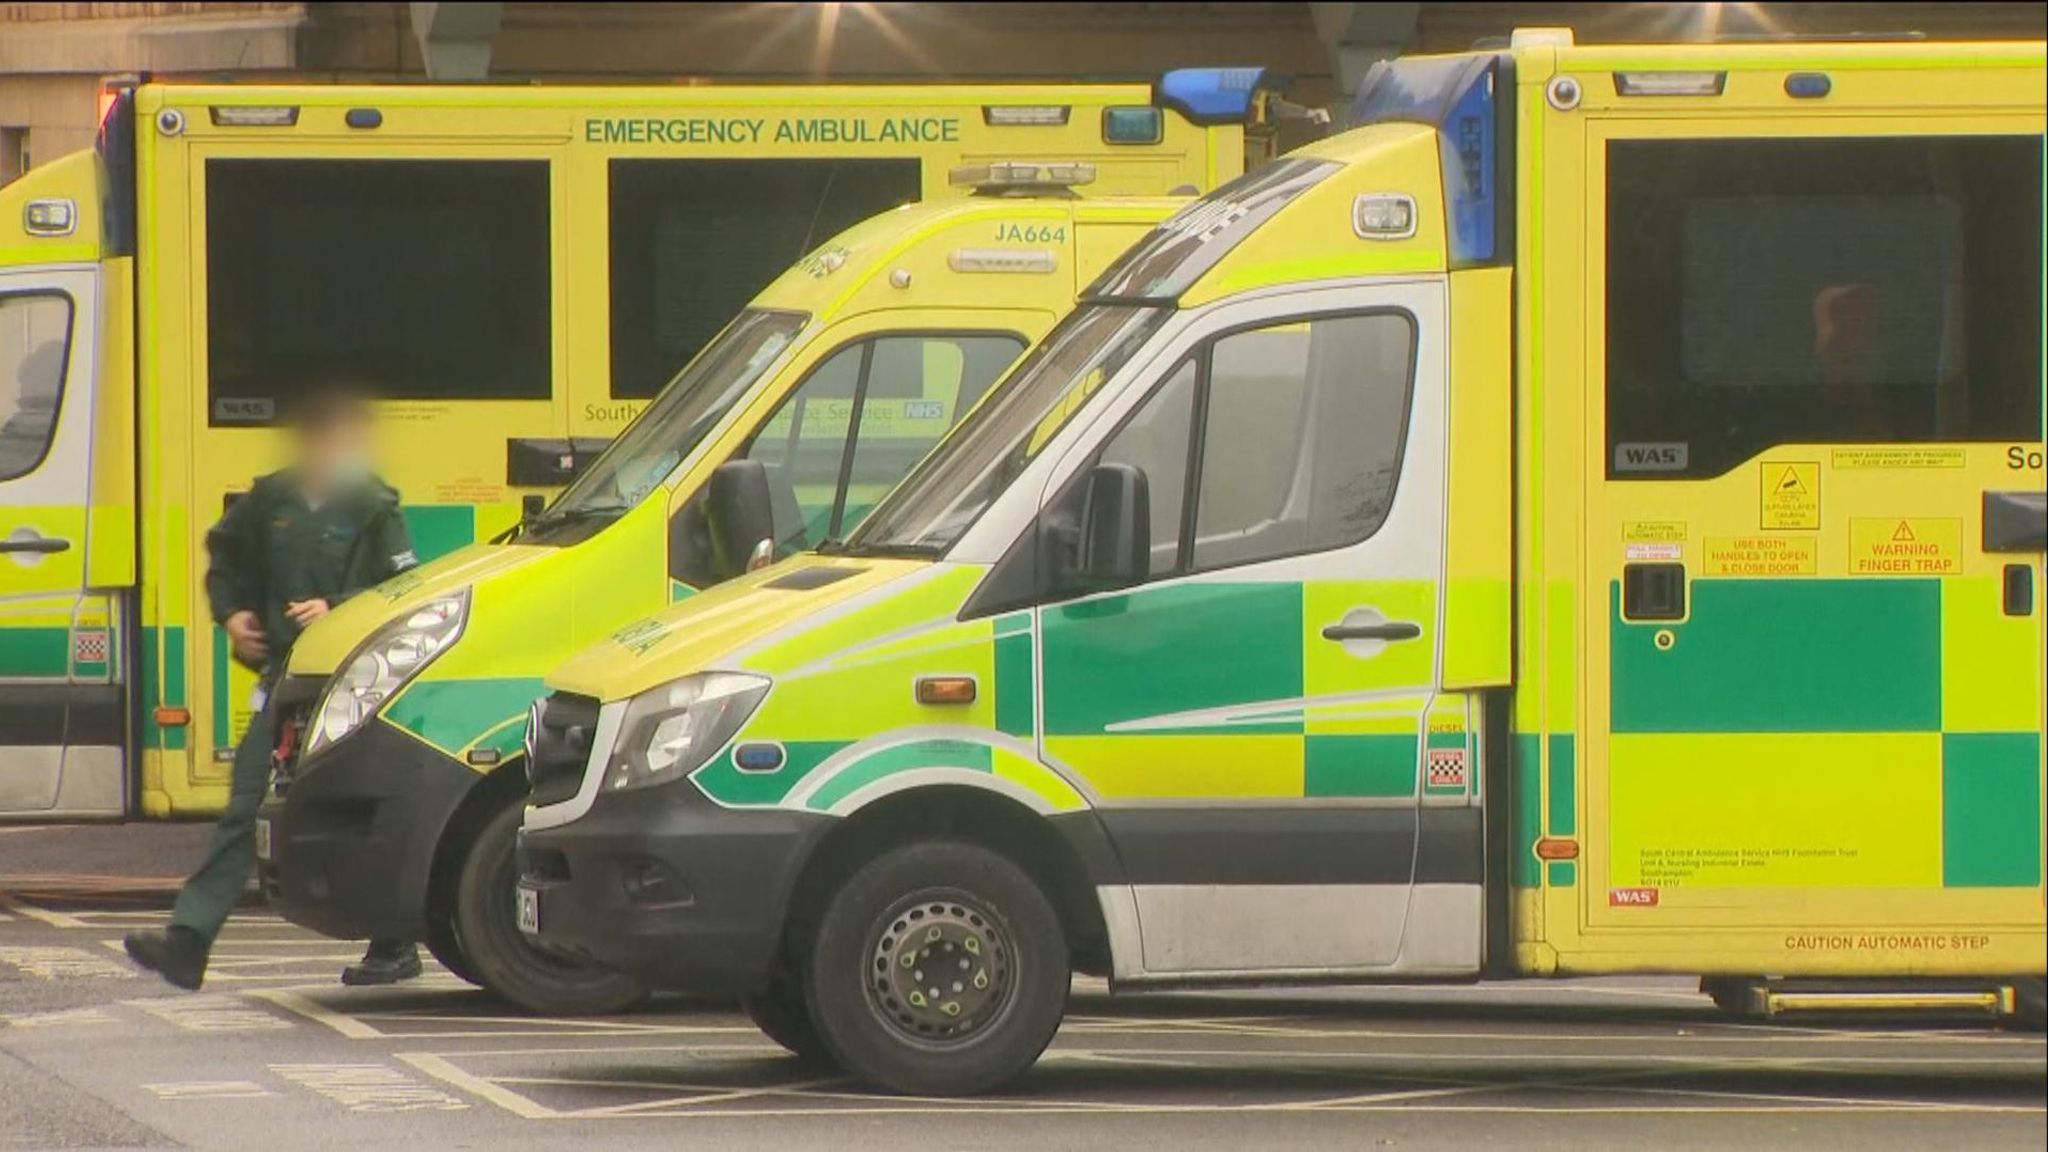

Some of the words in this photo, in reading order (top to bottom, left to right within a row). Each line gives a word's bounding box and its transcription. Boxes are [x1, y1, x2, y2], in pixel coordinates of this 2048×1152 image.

[586, 119, 764, 142] EMERGENCY
[774, 119, 959, 143] AMBULANCE
[995, 223, 1065, 244] JA664
[828, 403, 893, 419] Seice
[905, 402, 943, 418] NHS
[1625, 448, 1676, 464] WAS
[2007, 446, 2043, 469] So
[1734, 540, 1756, 550] USE
[1758, 540, 1786, 550] BOTH
[1872, 543, 1939, 556] WARNING
[1711, 551, 1761, 561] HANDLES
[1764, 551, 1777, 561] TO
[1779, 551, 1809, 561] OPEN
[1731, 563, 1766, 572] CLOSE
[1768, 563, 1799, 573] DOOR
[1859, 559, 1911, 571] FINGER
[1915, 559, 1953, 571] TRAP
[1429, 724, 1464, 732] DIESEL
[1615, 890, 1652, 903] WAS
[1785, 936, 1853, 949] CAUTION
[1858, 936, 1946, 949] AUTOMATIC
[1951, 936, 1990, 949] STEP
